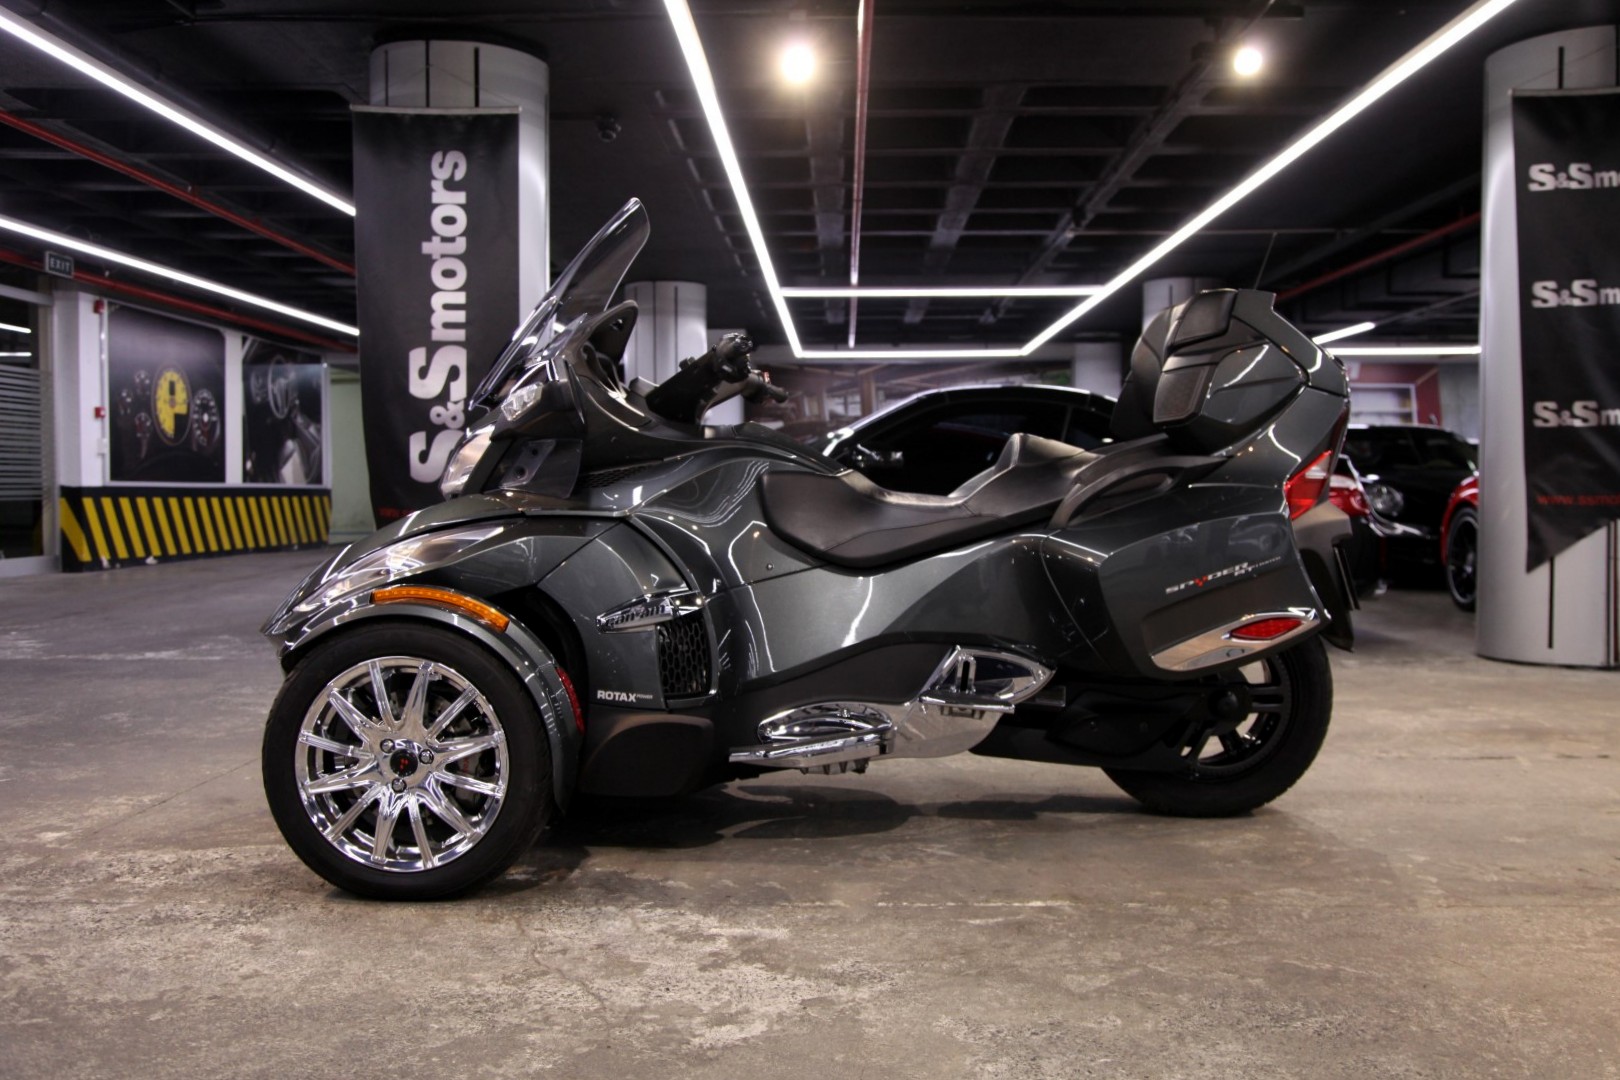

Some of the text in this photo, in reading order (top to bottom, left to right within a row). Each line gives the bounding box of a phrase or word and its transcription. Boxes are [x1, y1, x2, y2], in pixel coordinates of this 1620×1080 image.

[1528, 163, 1620, 191] S&Sm
[50, 257, 70, 272] EXIT
[409, 149, 468, 484] S&Smotors
[597, 689, 637, 703] ROTAX
